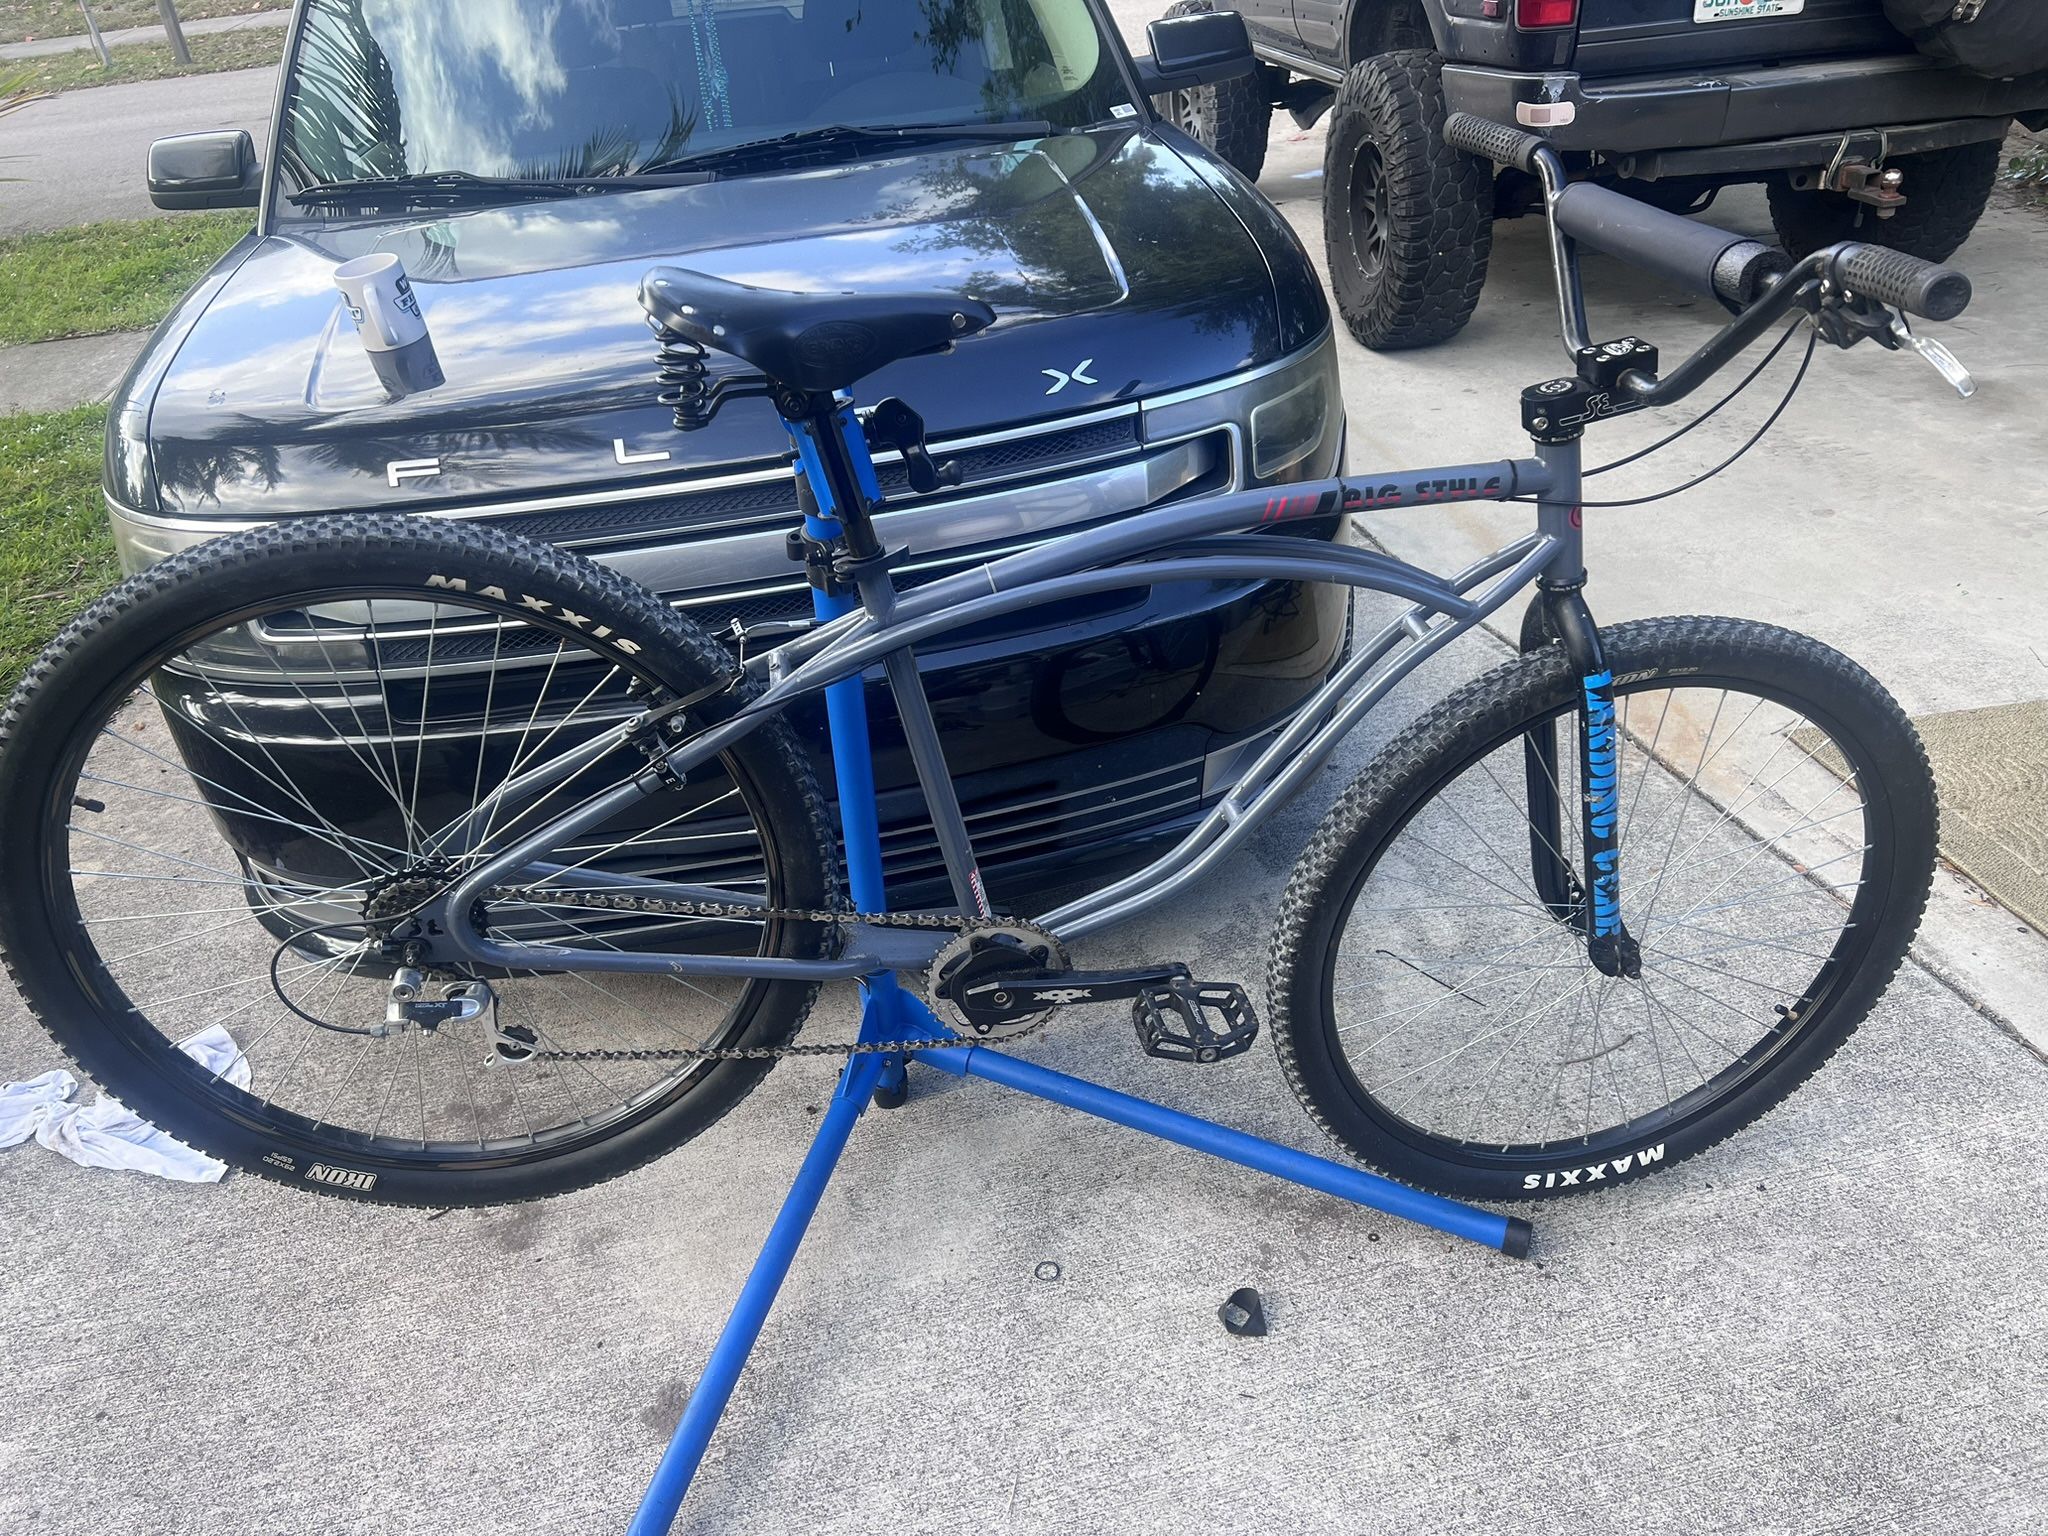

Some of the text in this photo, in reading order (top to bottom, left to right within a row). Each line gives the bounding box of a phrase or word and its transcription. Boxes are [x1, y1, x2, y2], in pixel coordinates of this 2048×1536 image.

[1719, 6, 1754, 17] SUNSHINE
[1757, 3, 1780, 13] STATE
[387, 457, 441, 487] F
[613, 438, 670, 465] L
[1344, 484, 1402, 508] BIG
[425, 574, 642, 655] MAXXIS
[1583, 668, 1618, 838] LANDING
[1592, 847, 1622, 937] GEAR
[305, 1163, 377, 1191] IKON
[1523, 1143, 1665, 1189] MAXXIS
